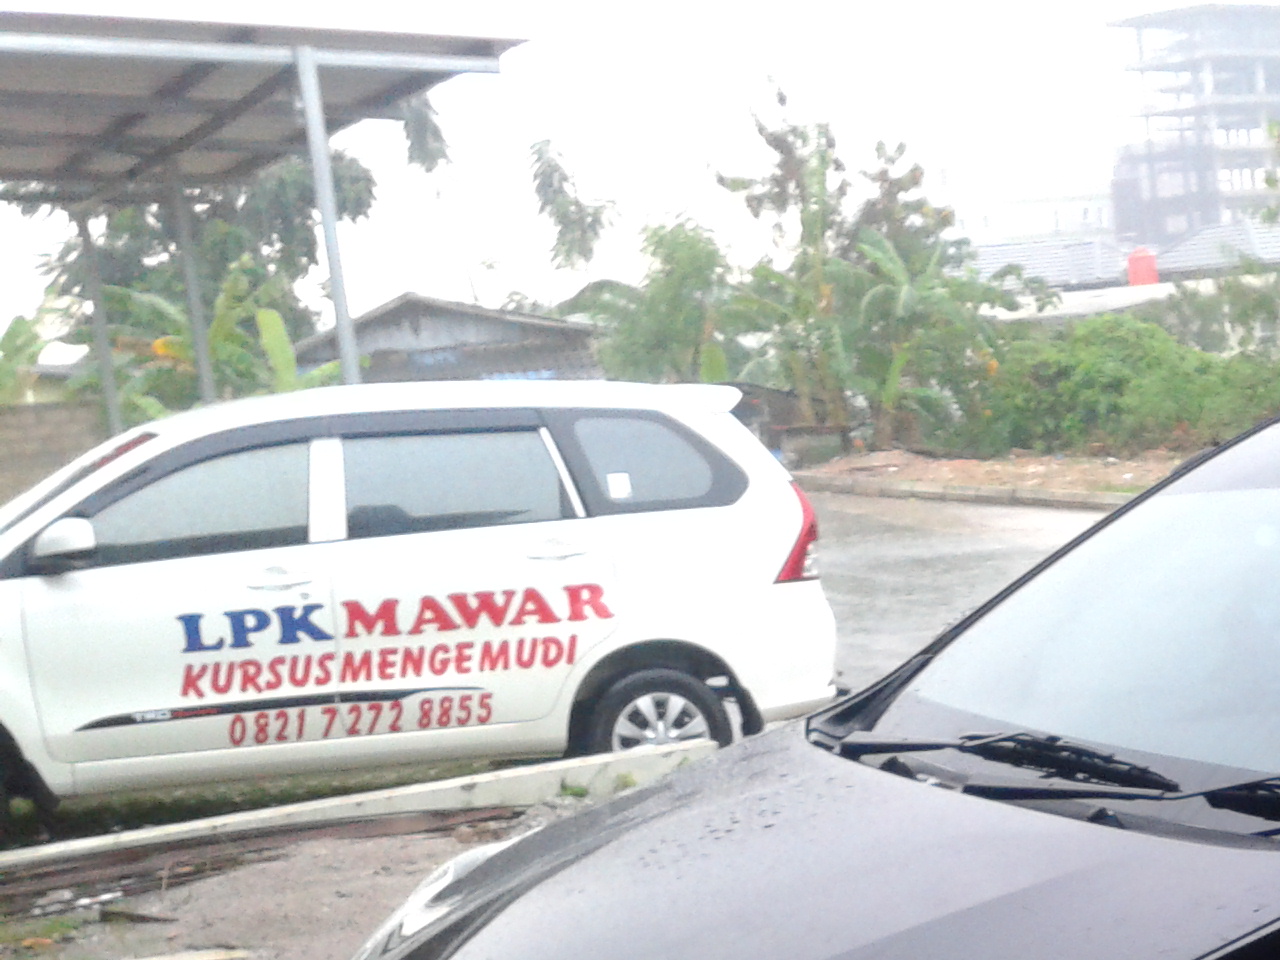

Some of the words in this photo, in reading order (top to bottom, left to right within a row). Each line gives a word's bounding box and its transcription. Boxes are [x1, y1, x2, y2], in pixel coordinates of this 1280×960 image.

[176, 603, 335, 653] LPK
[341, 583, 615, 639] MAWAR
[180, 652, 335, 699] KURSUS
[339, 634, 578, 683] MENGEMUDI
[229, 708, 307, 746] 0821
[320, 699, 403, 739] 7272
[417, 693, 493, 729] 8855
